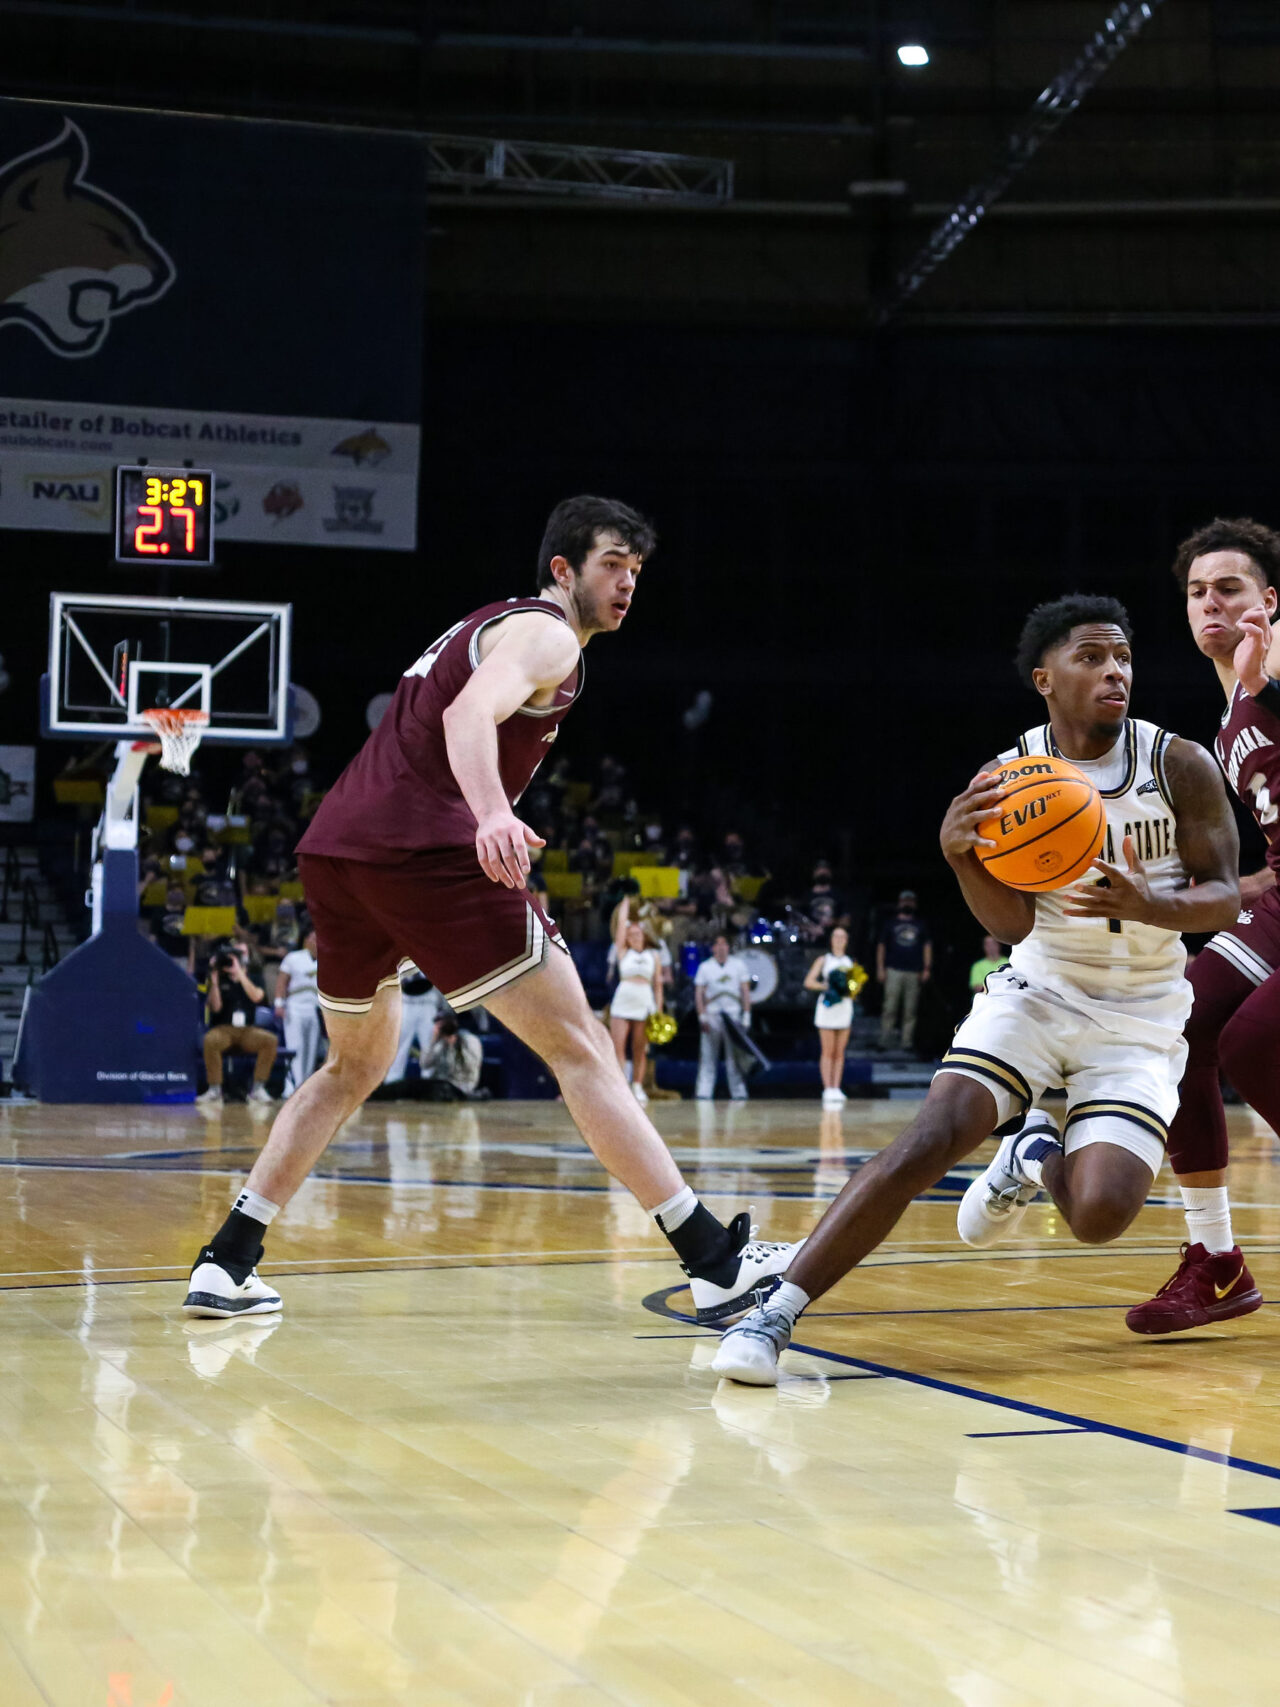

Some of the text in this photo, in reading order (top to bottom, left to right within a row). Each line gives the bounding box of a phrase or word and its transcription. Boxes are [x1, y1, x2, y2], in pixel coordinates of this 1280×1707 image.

[80, 414, 104, 434] of
[110, 416, 191, 439] Bobcat
[199, 422, 303, 445] Athletics
[33, 481, 99, 501] NAU
[146, 477, 204, 507] 3:27
[134, 505, 196, 554] 2.7
[1227, 725, 1275, 789] ONTANA
[998, 763, 1053, 787] lson
[1000, 797, 1047, 836] EVO
